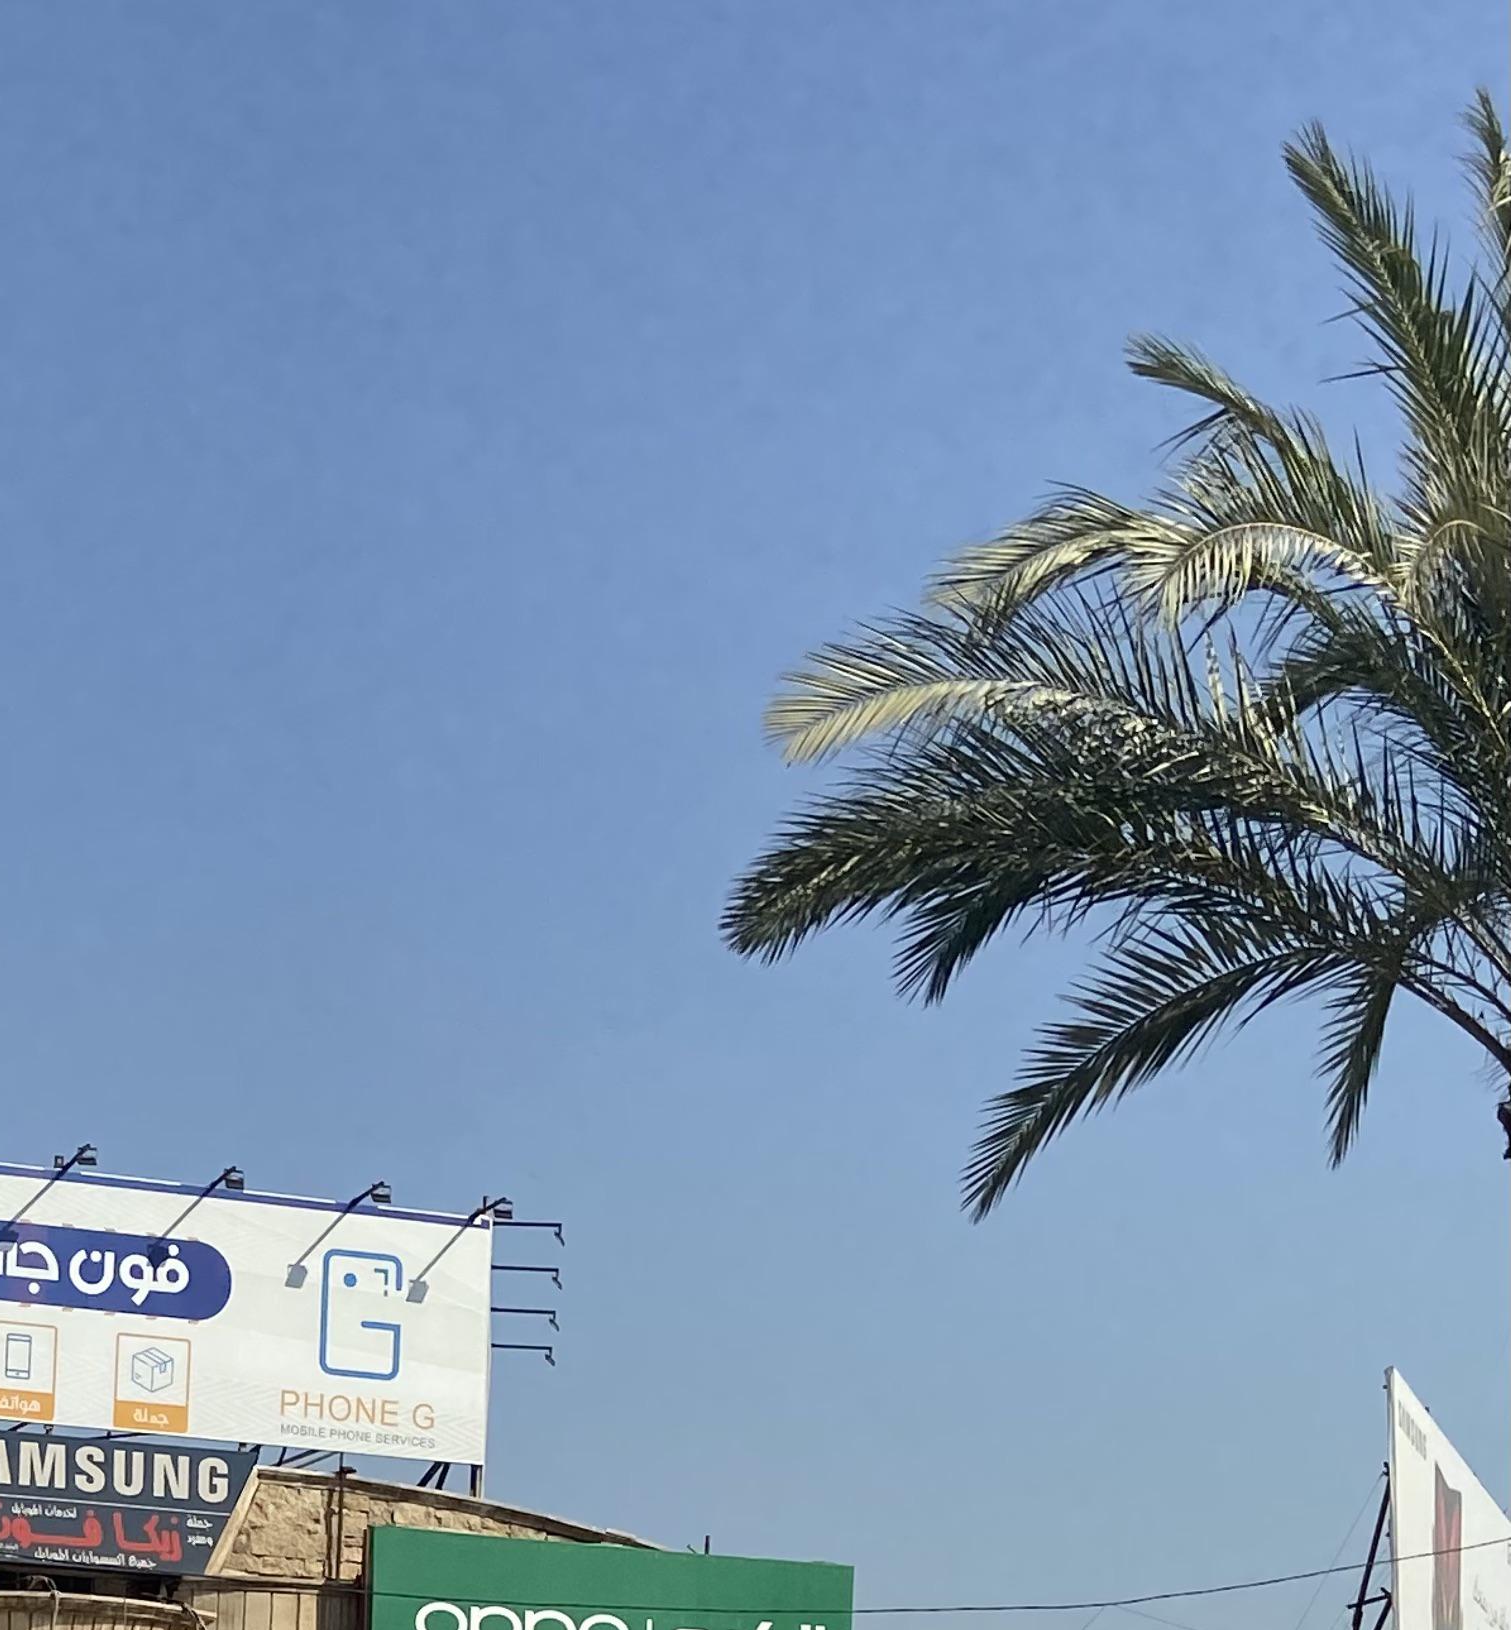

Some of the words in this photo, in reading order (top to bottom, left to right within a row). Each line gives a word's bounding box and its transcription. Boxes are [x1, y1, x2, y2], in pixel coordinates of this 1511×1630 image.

[70, 1244, 190, 1306] فون
[132, 1408, 169, 1427] جملة
[280, 1389, 399, 1427] PHONE
[412, 1403, 436, 1430] G
[280, 1424, 326, 1438] MOBILE
[330, 1430, 372, 1442] PHONE
[375, 1434, 436, 1449] SERVICES
[113, 1511, 183, 1562] زيكا
